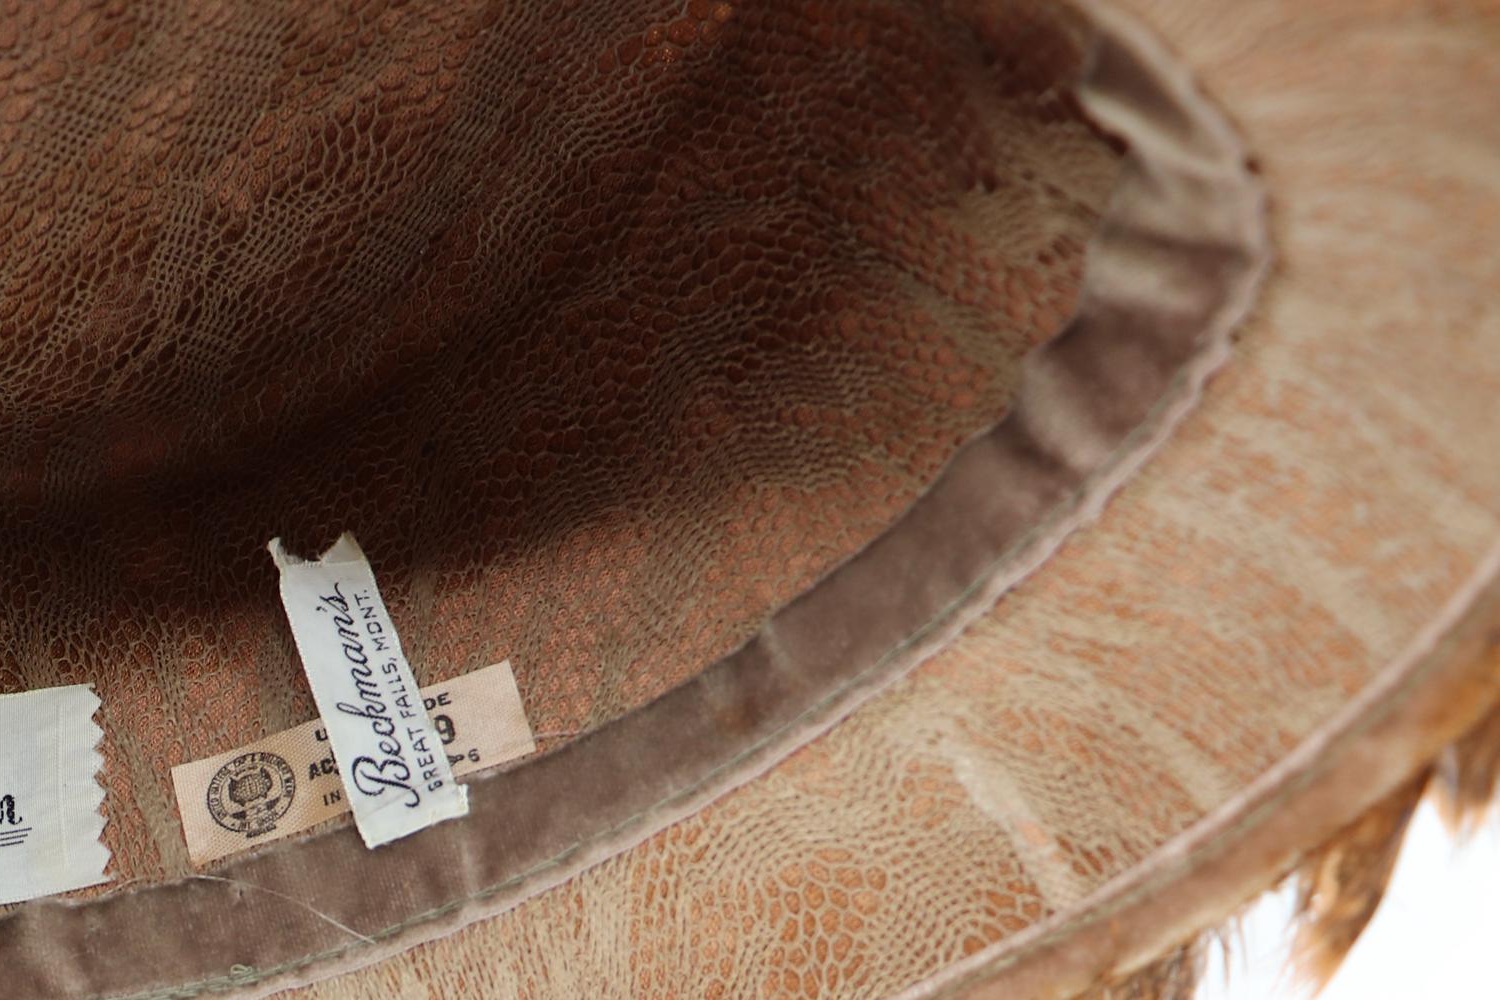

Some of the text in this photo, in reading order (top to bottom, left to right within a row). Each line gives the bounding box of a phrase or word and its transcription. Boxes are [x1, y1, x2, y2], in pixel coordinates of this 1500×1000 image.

[315, 581, 420, 808] Beckman's
[353, 589, 444, 792] GREAT FALLS, MONT.
